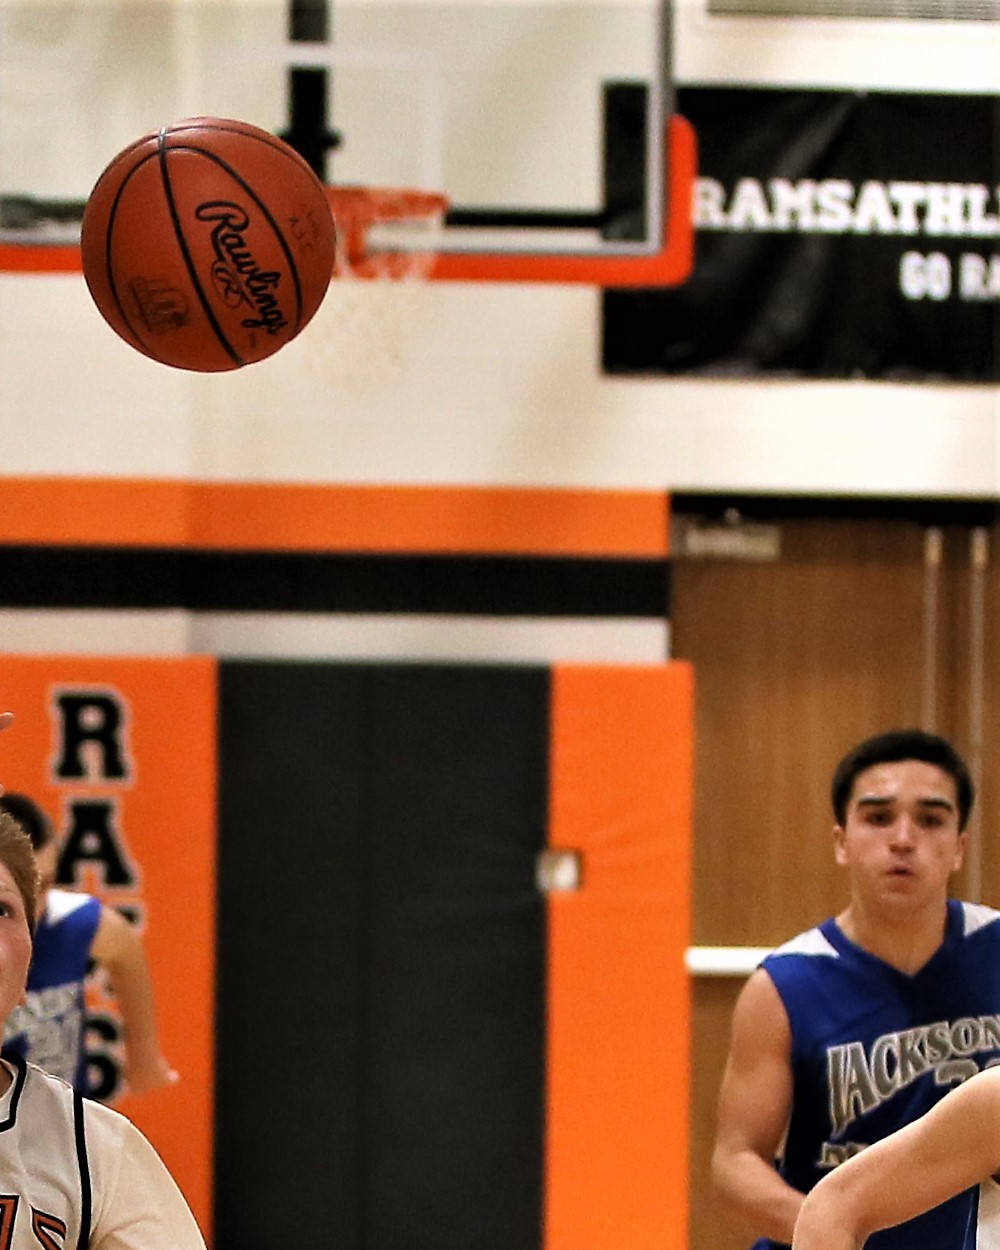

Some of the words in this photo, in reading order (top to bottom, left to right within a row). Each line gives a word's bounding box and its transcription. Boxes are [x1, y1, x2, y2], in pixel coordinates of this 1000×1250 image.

[692, 177, 1000, 237] RAMSATHL
[195, 201, 287, 334] Rawlings
[900, 251, 952, 300] GO
